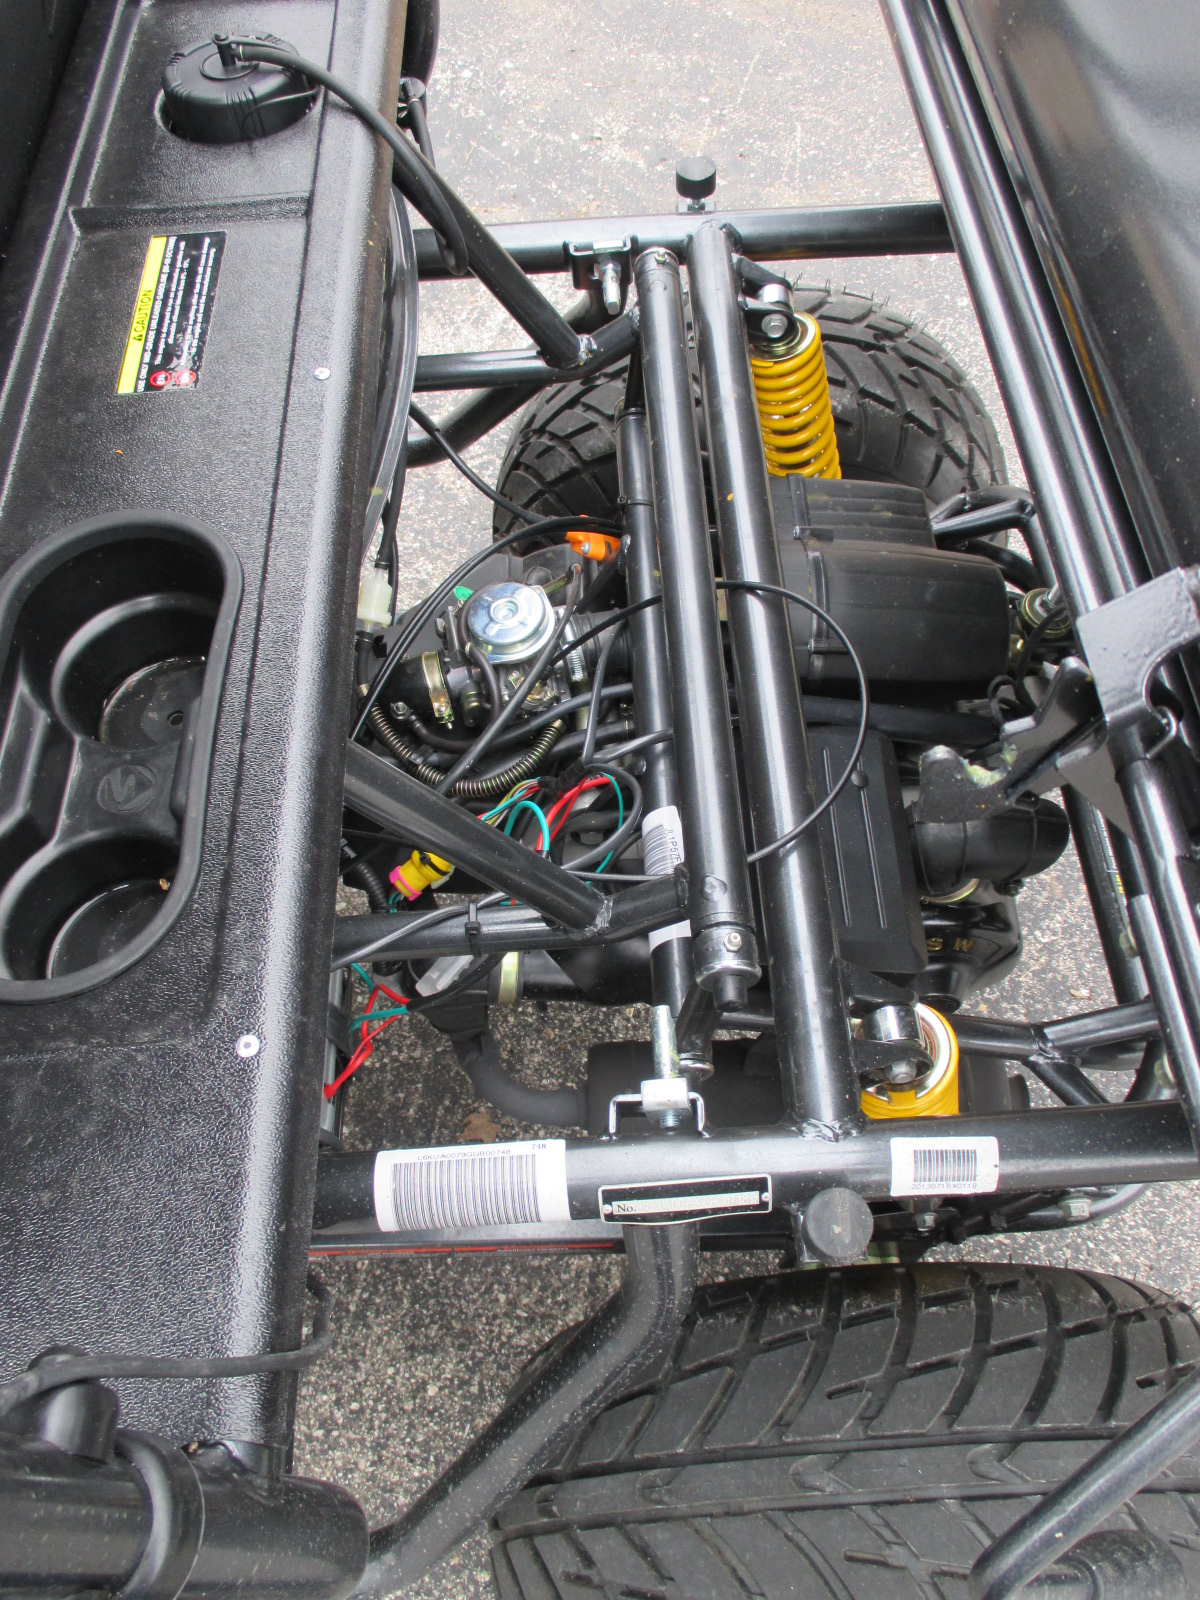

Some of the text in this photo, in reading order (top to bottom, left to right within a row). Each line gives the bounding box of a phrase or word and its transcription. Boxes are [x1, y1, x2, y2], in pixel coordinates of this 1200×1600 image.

[156, 273, 168, 300] GASOLINE
[134, 289, 153, 331] CAUTION
[150, 300, 163, 330] UNLEADED
[143, 330, 157, 363] MID-GRADE
[140, 364, 149, 379] ONLY
[137, 380, 146, 392] USE
[531, 1143, 547, 1151] 748
[617, 1203, 637, 1213] No.
